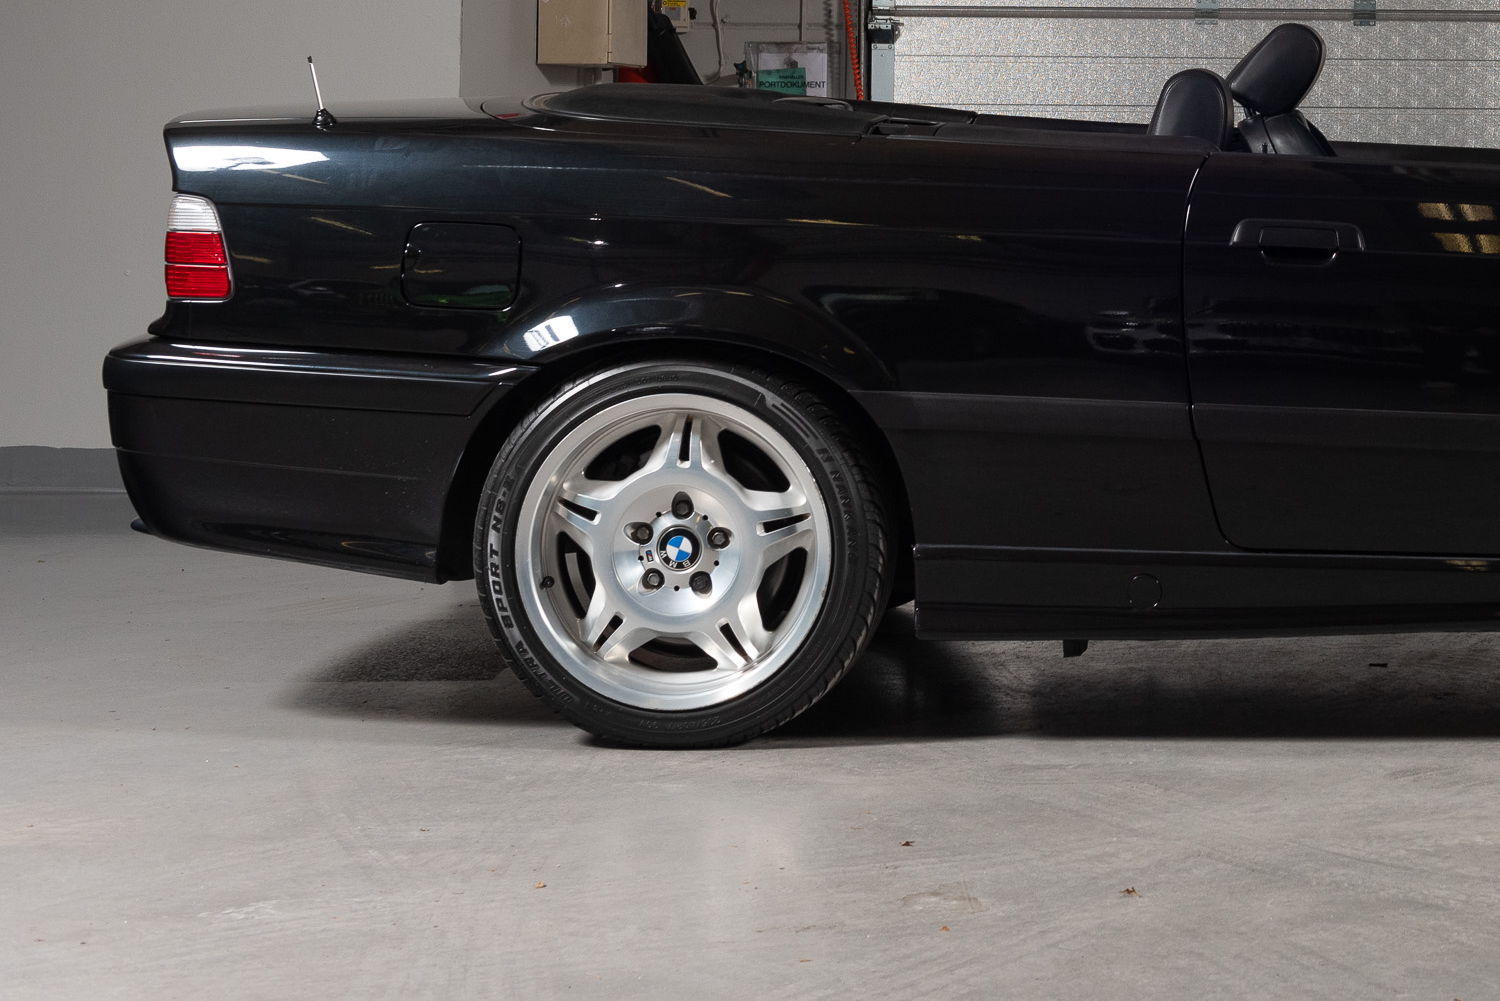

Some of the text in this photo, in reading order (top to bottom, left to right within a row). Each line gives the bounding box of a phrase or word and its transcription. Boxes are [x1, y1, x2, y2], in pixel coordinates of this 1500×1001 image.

[759, 80, 826, 88] PORTDOKUMENT
[660, 550, 691, 567] BMW
[489, 543, 514, 630] SPORT
